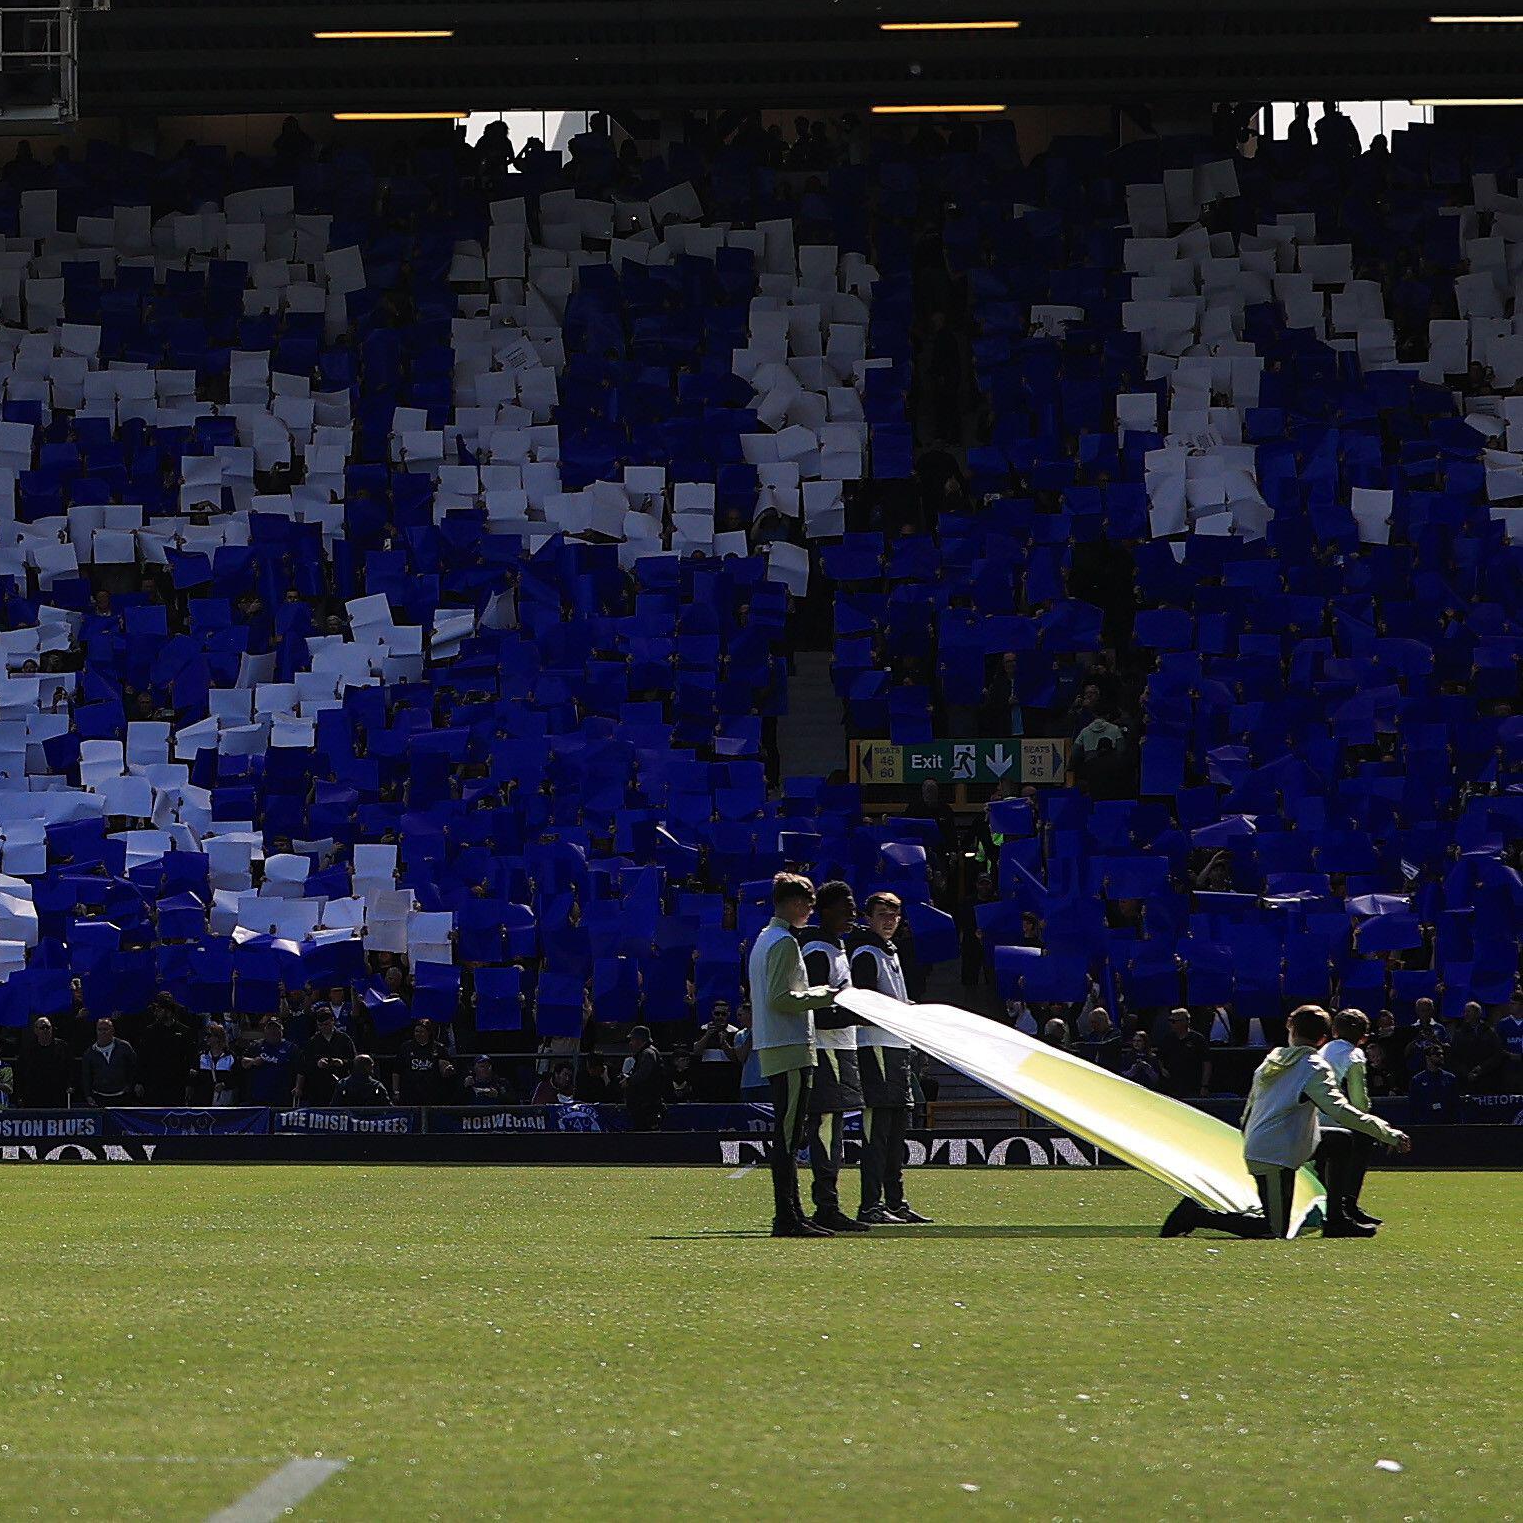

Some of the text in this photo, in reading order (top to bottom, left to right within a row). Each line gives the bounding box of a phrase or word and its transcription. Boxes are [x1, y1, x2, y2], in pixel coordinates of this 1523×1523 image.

[911, 754, 942, 769] Exit
[47, 1116, 96, 1137] BLUES
[280, 1111, 408, 1134] THE IRISH TOFFEES
[462, 1113, 546, 1130] NORWEGIAN
